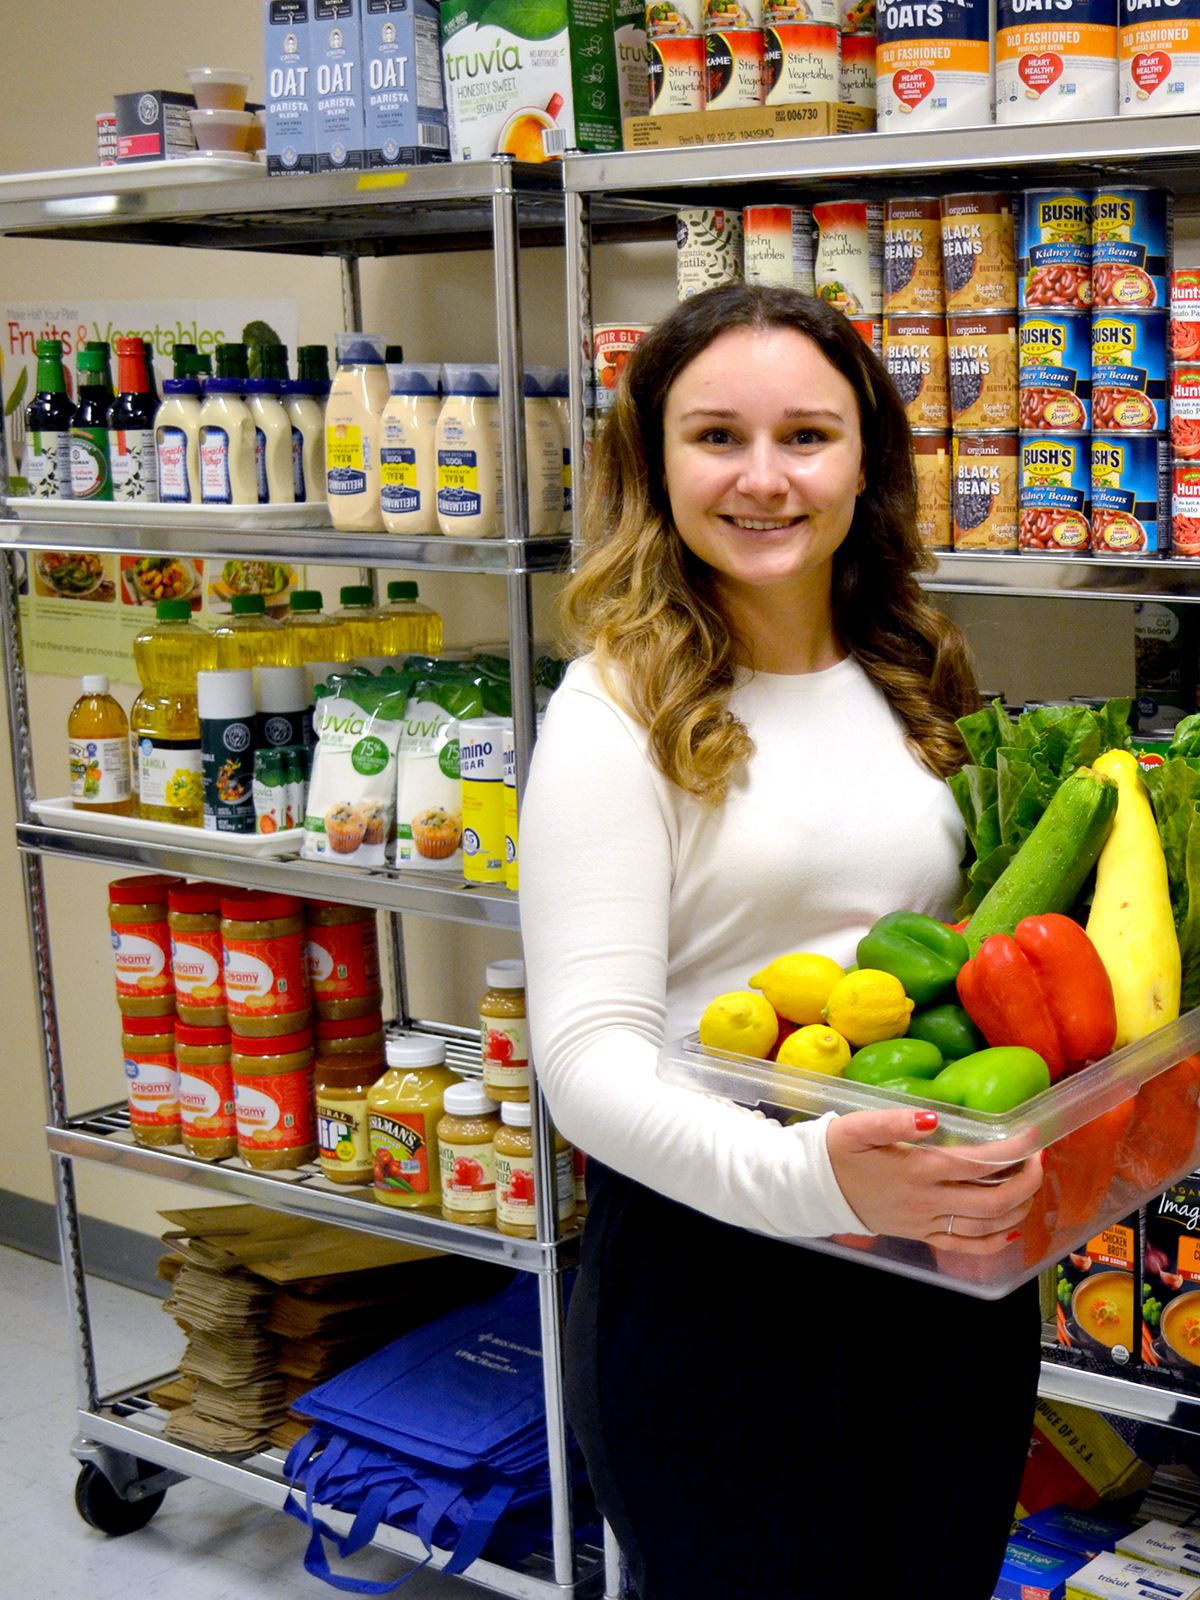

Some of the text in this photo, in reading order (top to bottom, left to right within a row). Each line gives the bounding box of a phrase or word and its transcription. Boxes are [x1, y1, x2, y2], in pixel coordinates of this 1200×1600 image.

[886, 4, 943, 30] OATS
[1007, 32, 1080, 47] OLD FASHIONED
[446, 38, 523, 81] truvía
[788, 53, 823, 67] Stir-Fry
[1028, 59, 1050, 67] HEART
[369, 57, 408, 90] OAT
[788, 67, 834, 82] Vegetables
[1025, 66, 1055, 75] HEALTHY
[270, 67, 308, 99] OAT
[317, 62, 354, 95] OAT
[318, 98, 355, 110] BARISTA
[370, 93, 409, 105] BARISTA
[270, 102, 309, 115] BARISTA
[787, 108, 818, 122] 006730
[949, 204, 979, 216] organic
[1108, 248, 1138, 258] Beans
[76, 321, 88, 351] &
[898, 326, 930, 336] organic
[888, 345, 930, 358] BLACK
[950, 345, 989, 358] BLACK
[888, 361, 930, 375] BEANS
[951, 361, 990, 375] BEANS
[1024, 450, 1072, 468] BUSH'S
[115, 953, 151, 965] Creamy
[131, 1082, 171, 1093] Creamy
[1107, 1245, 1127, 1258] BROTH
[1145, 1538, 1177, 1553] triscuit
[1097, 1573, 1131, 1590] triscuit
